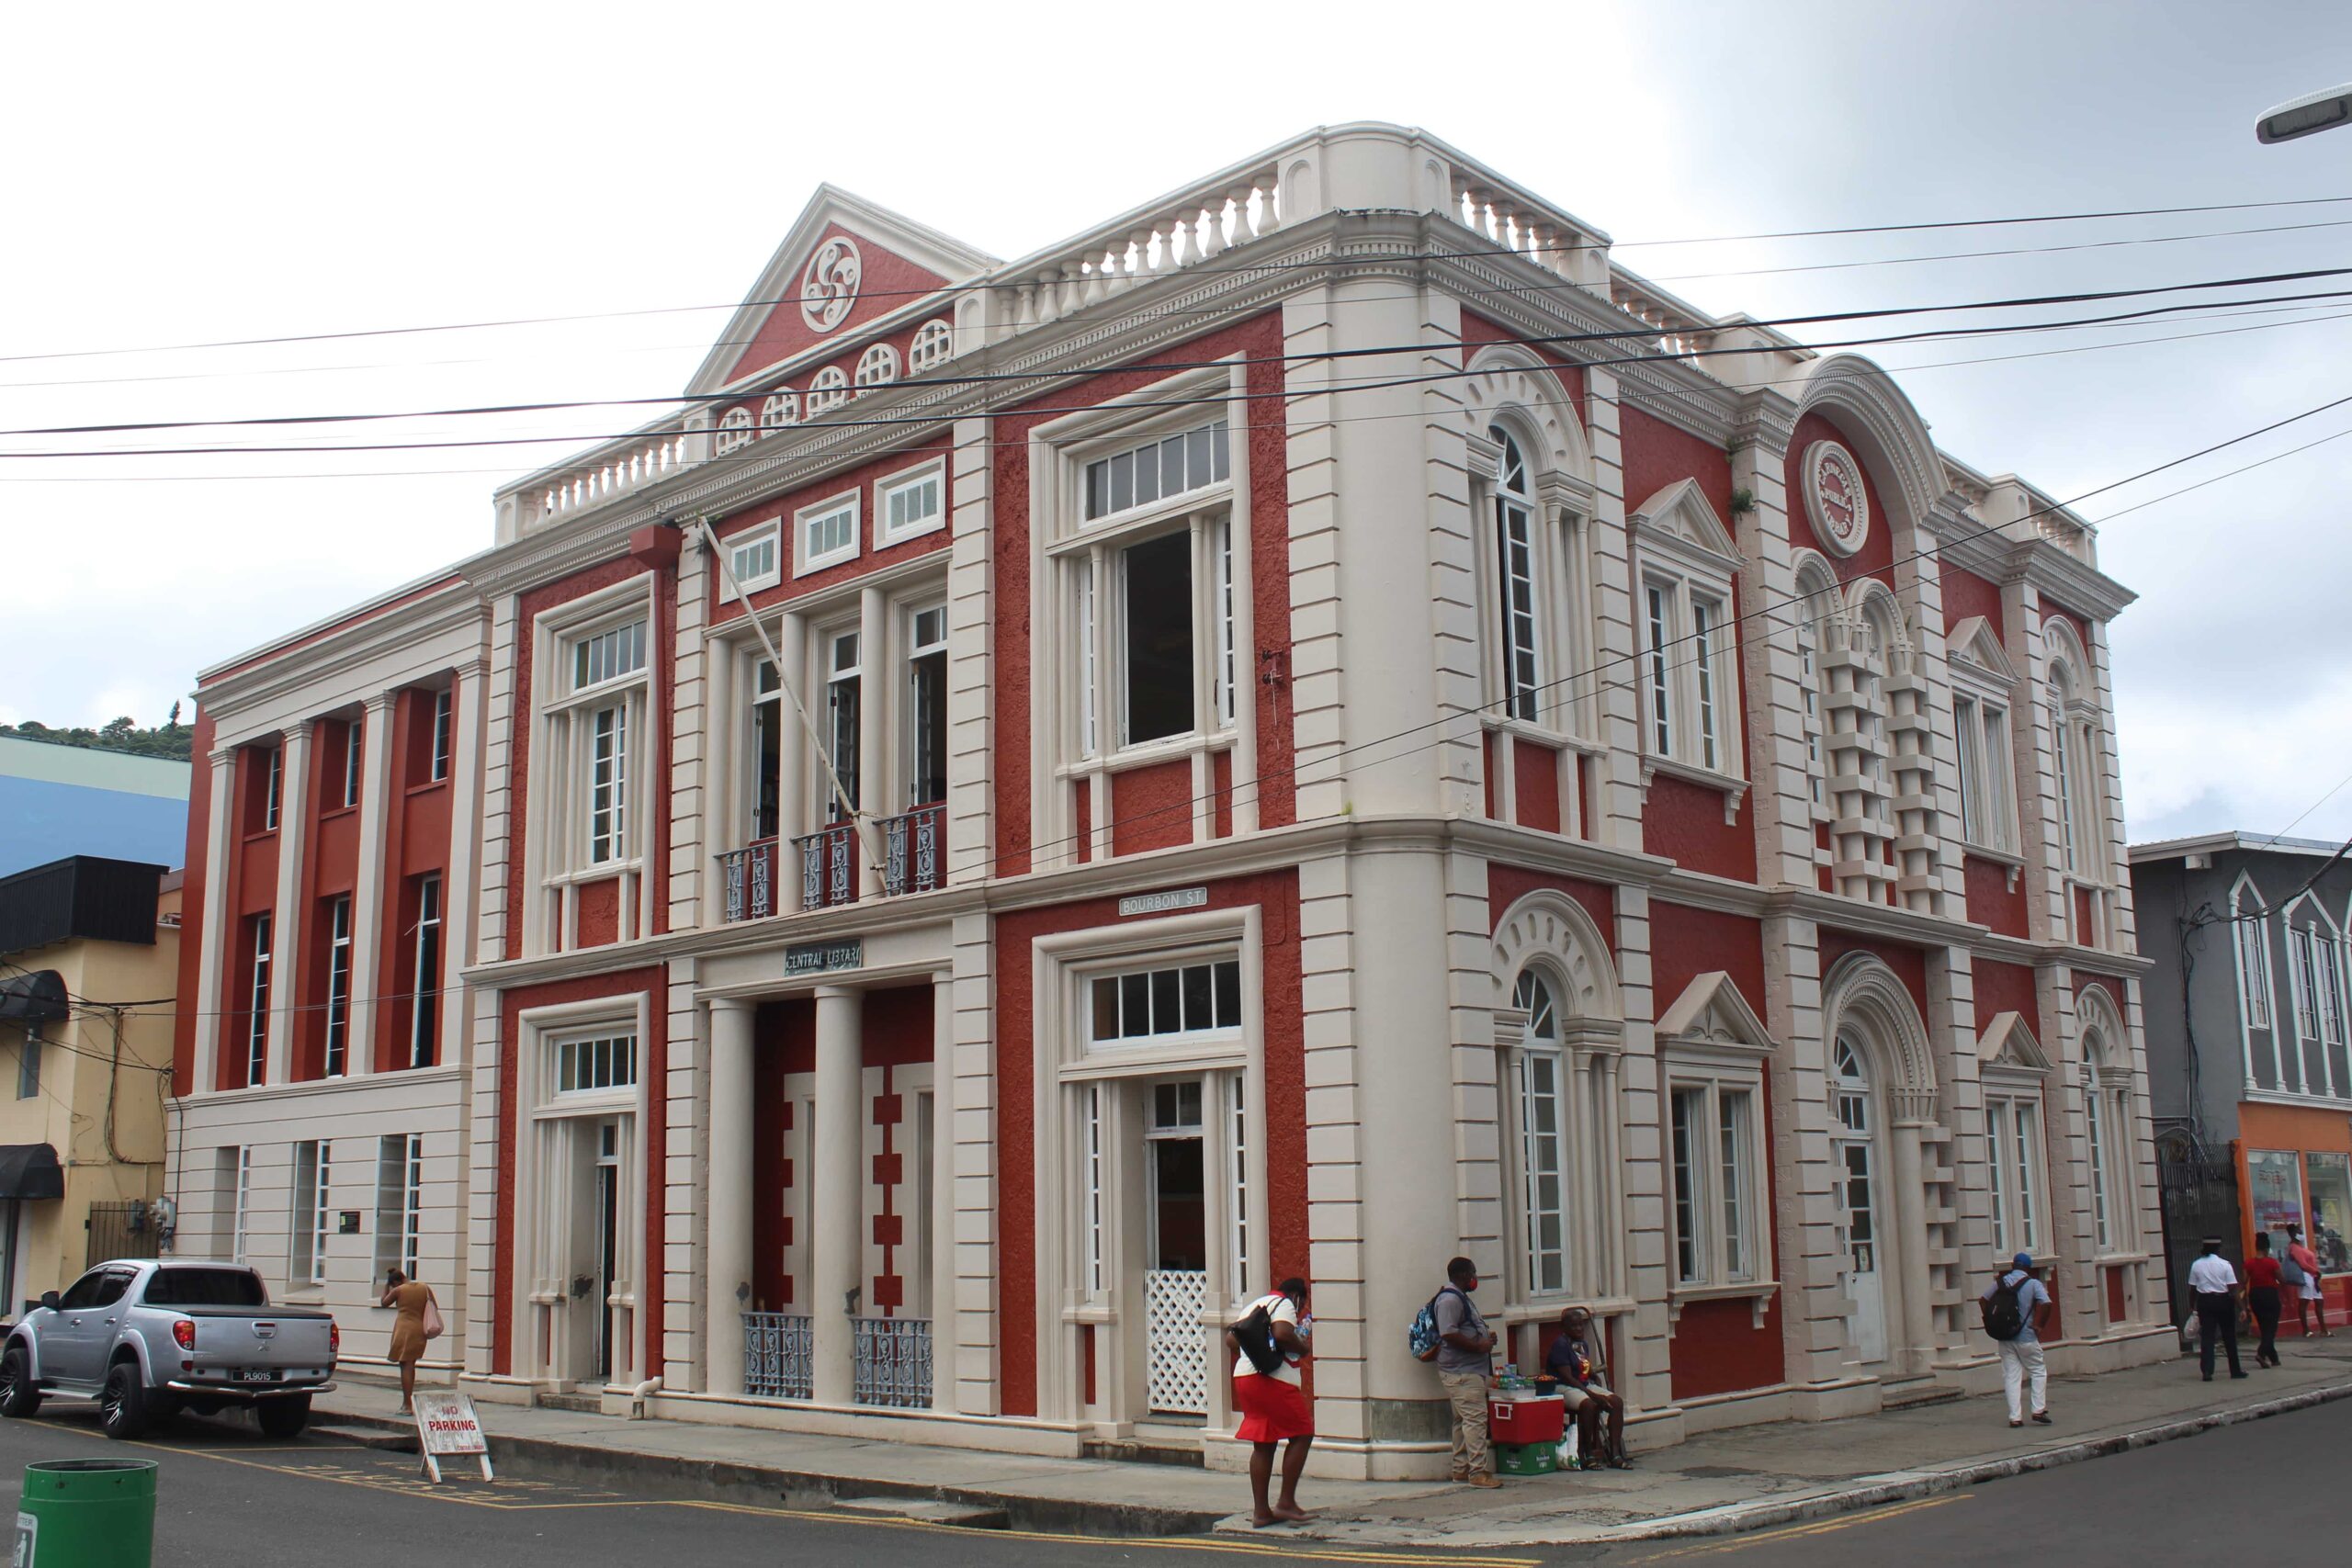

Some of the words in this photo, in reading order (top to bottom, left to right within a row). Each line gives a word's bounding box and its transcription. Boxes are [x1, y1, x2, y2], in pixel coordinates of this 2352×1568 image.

[1123, 894, 1180, 913] BOURBON
[1187, 890, 1205, 905] ST.
[243, 1371, 271, 1381] PL9015
[442, 1406, 458, 1416] NO
[429, 1420, 477, 1431] PARKING
